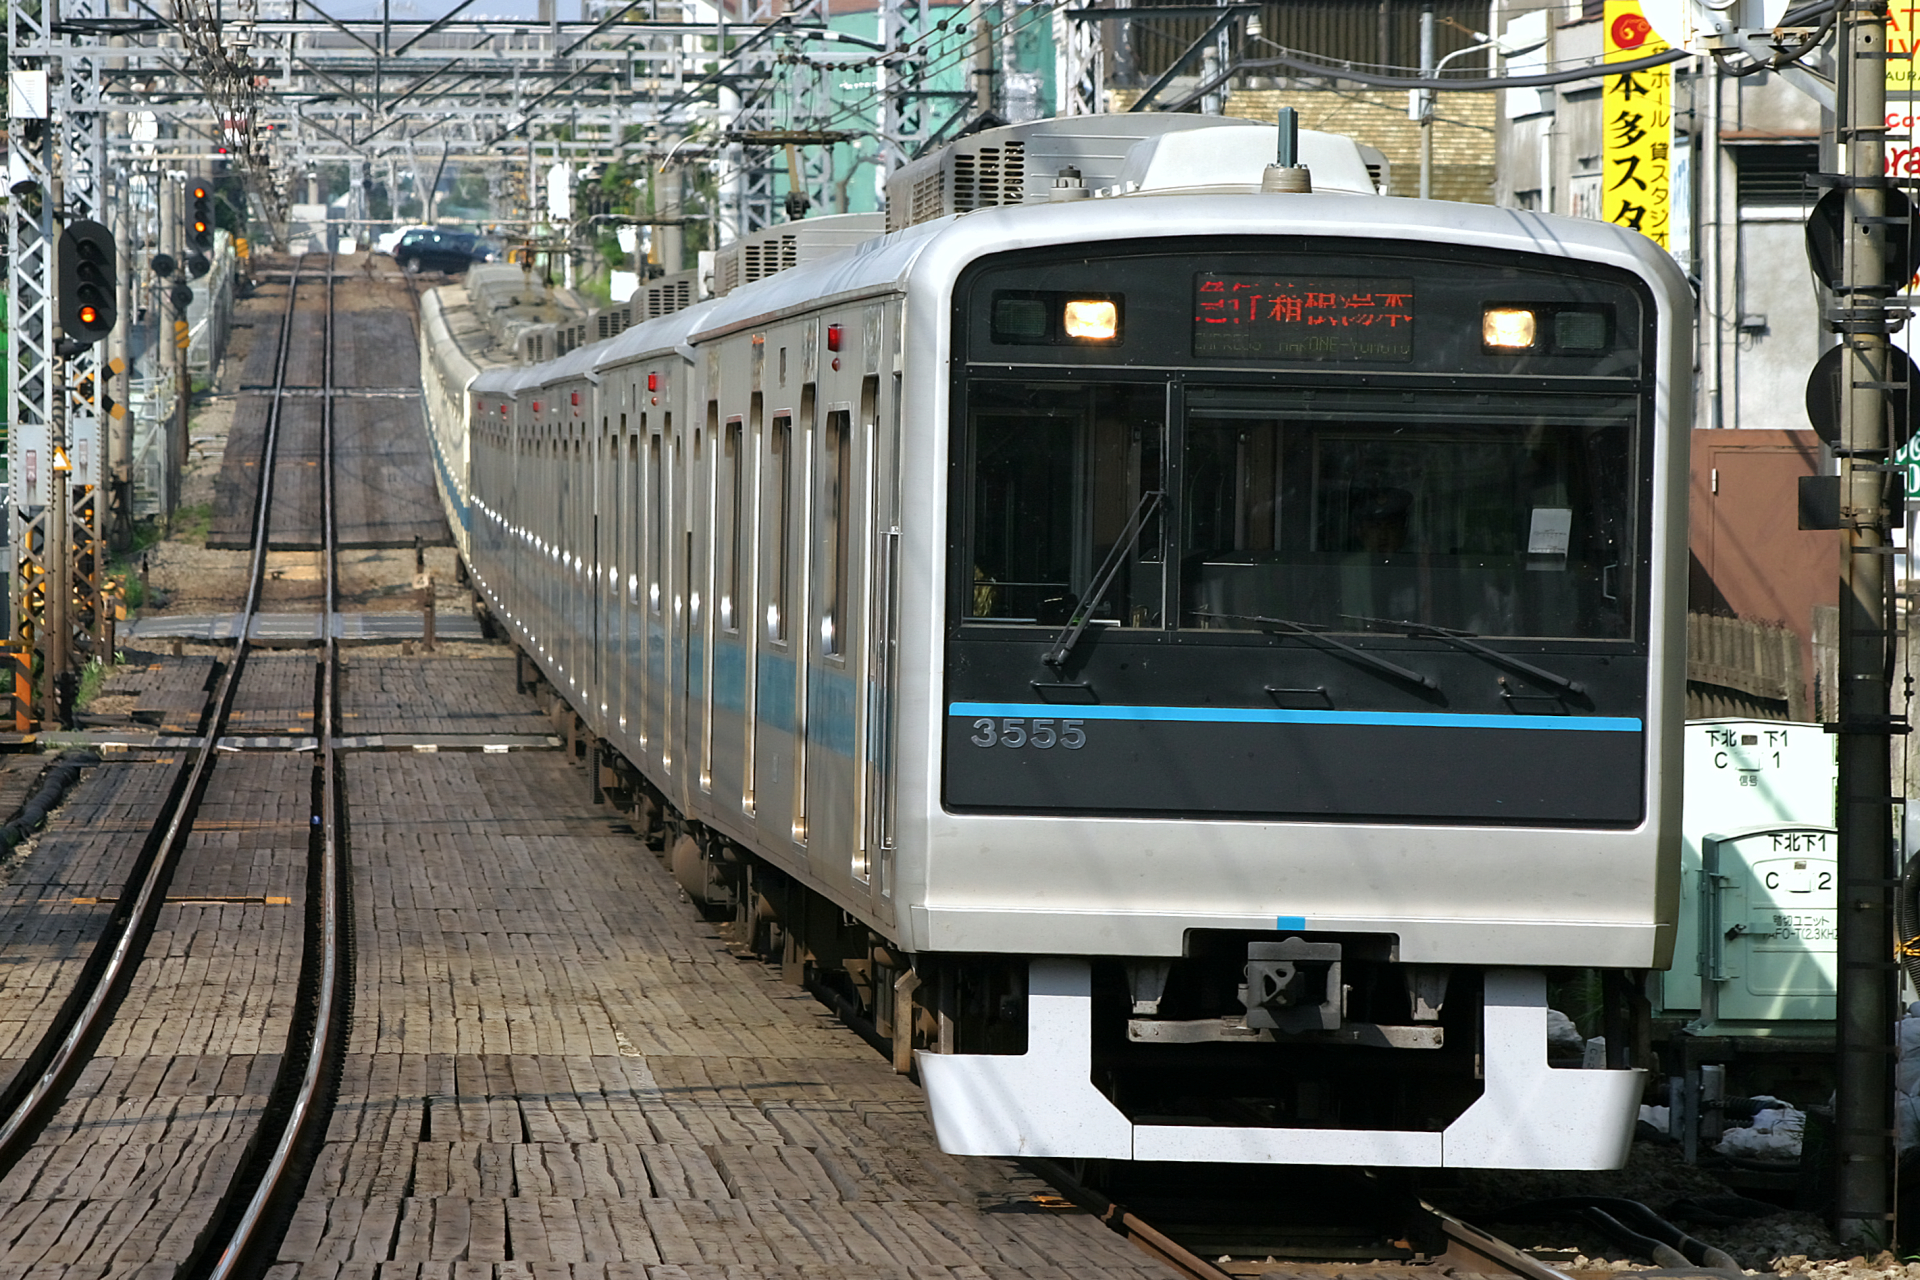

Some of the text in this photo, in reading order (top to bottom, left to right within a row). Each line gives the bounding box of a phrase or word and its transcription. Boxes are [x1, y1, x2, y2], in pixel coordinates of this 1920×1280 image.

[970, 717, 1087, 749] 3555
[1705, 729, 1737, 748] 下北
[1714, 751, 1728, 769] C
[1765, 871, 1832, 890] C 2
